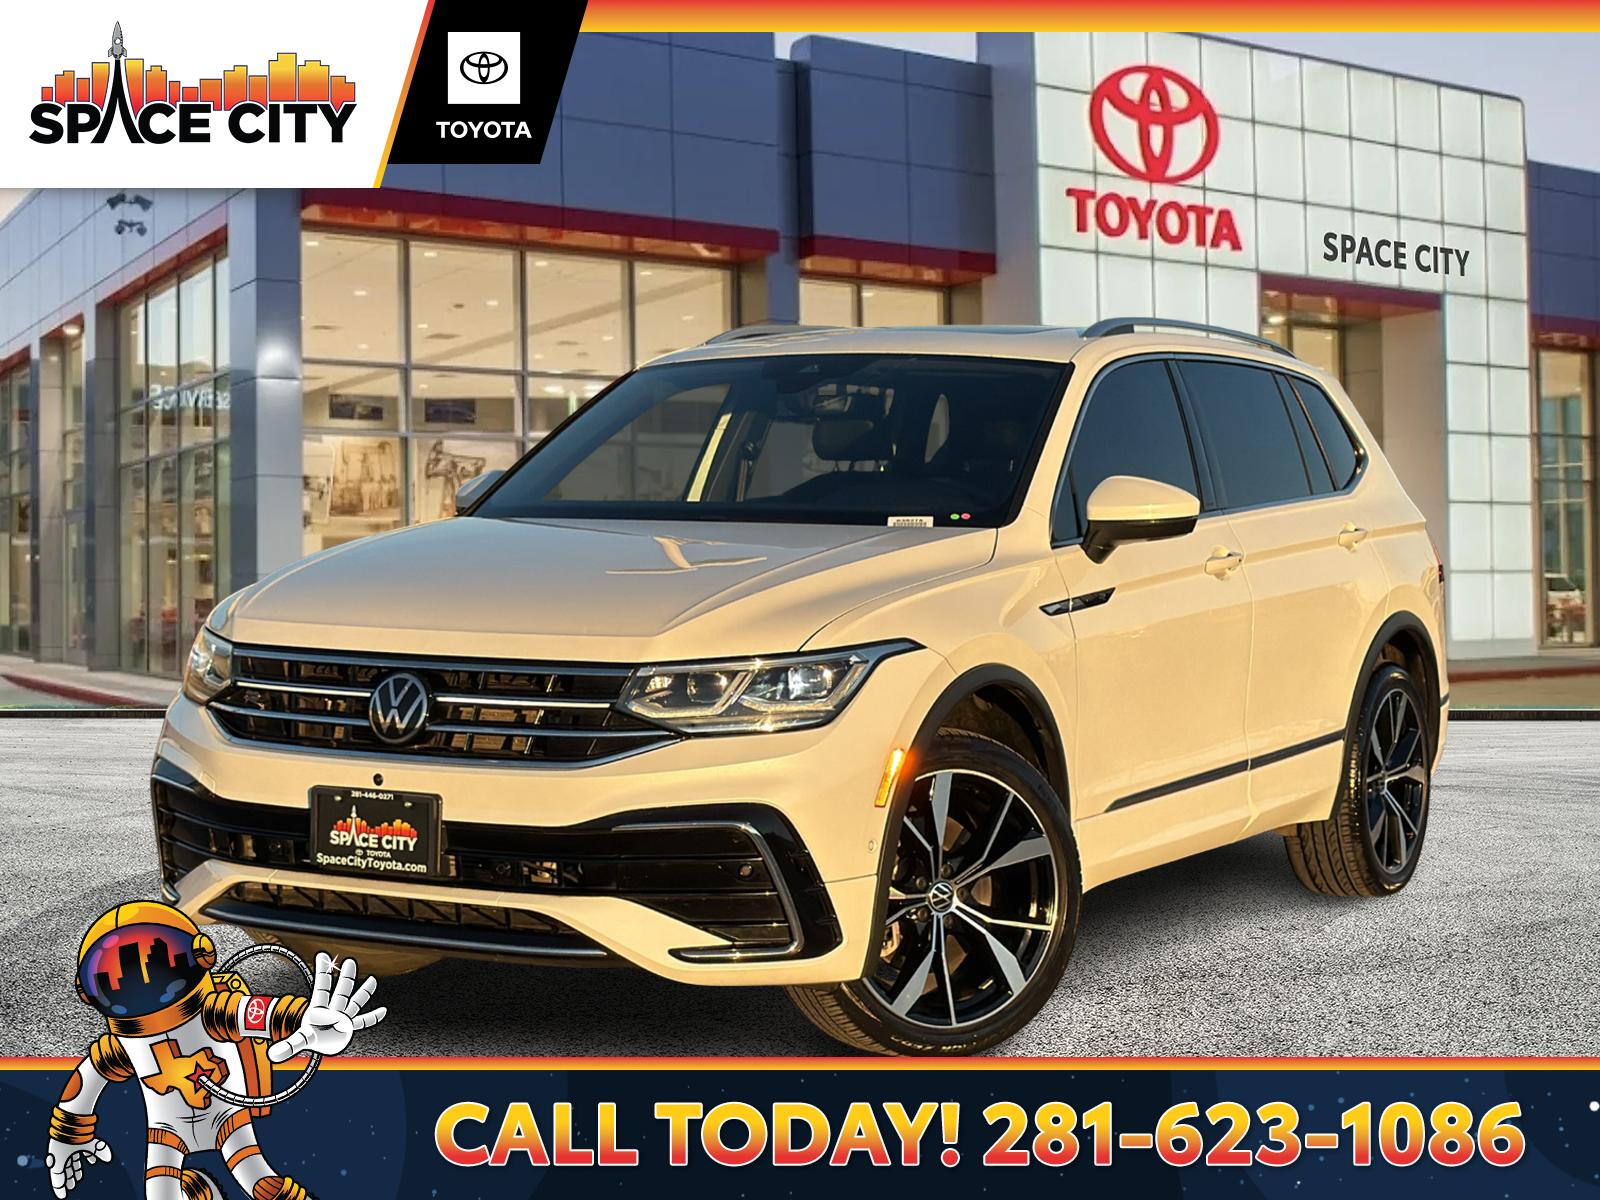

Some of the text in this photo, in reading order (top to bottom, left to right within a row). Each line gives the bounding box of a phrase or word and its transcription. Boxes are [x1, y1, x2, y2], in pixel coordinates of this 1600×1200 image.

[1065, 187, 1243, 251] TOYOTA
[1322, 231, 1471, 277] SPACE CITY
[329, 826, 418, 852] SPACE CITY
[316, 853, 427, 873] SpaceCityToyota.com
[366, 850, 391, 858] TOYOTA
